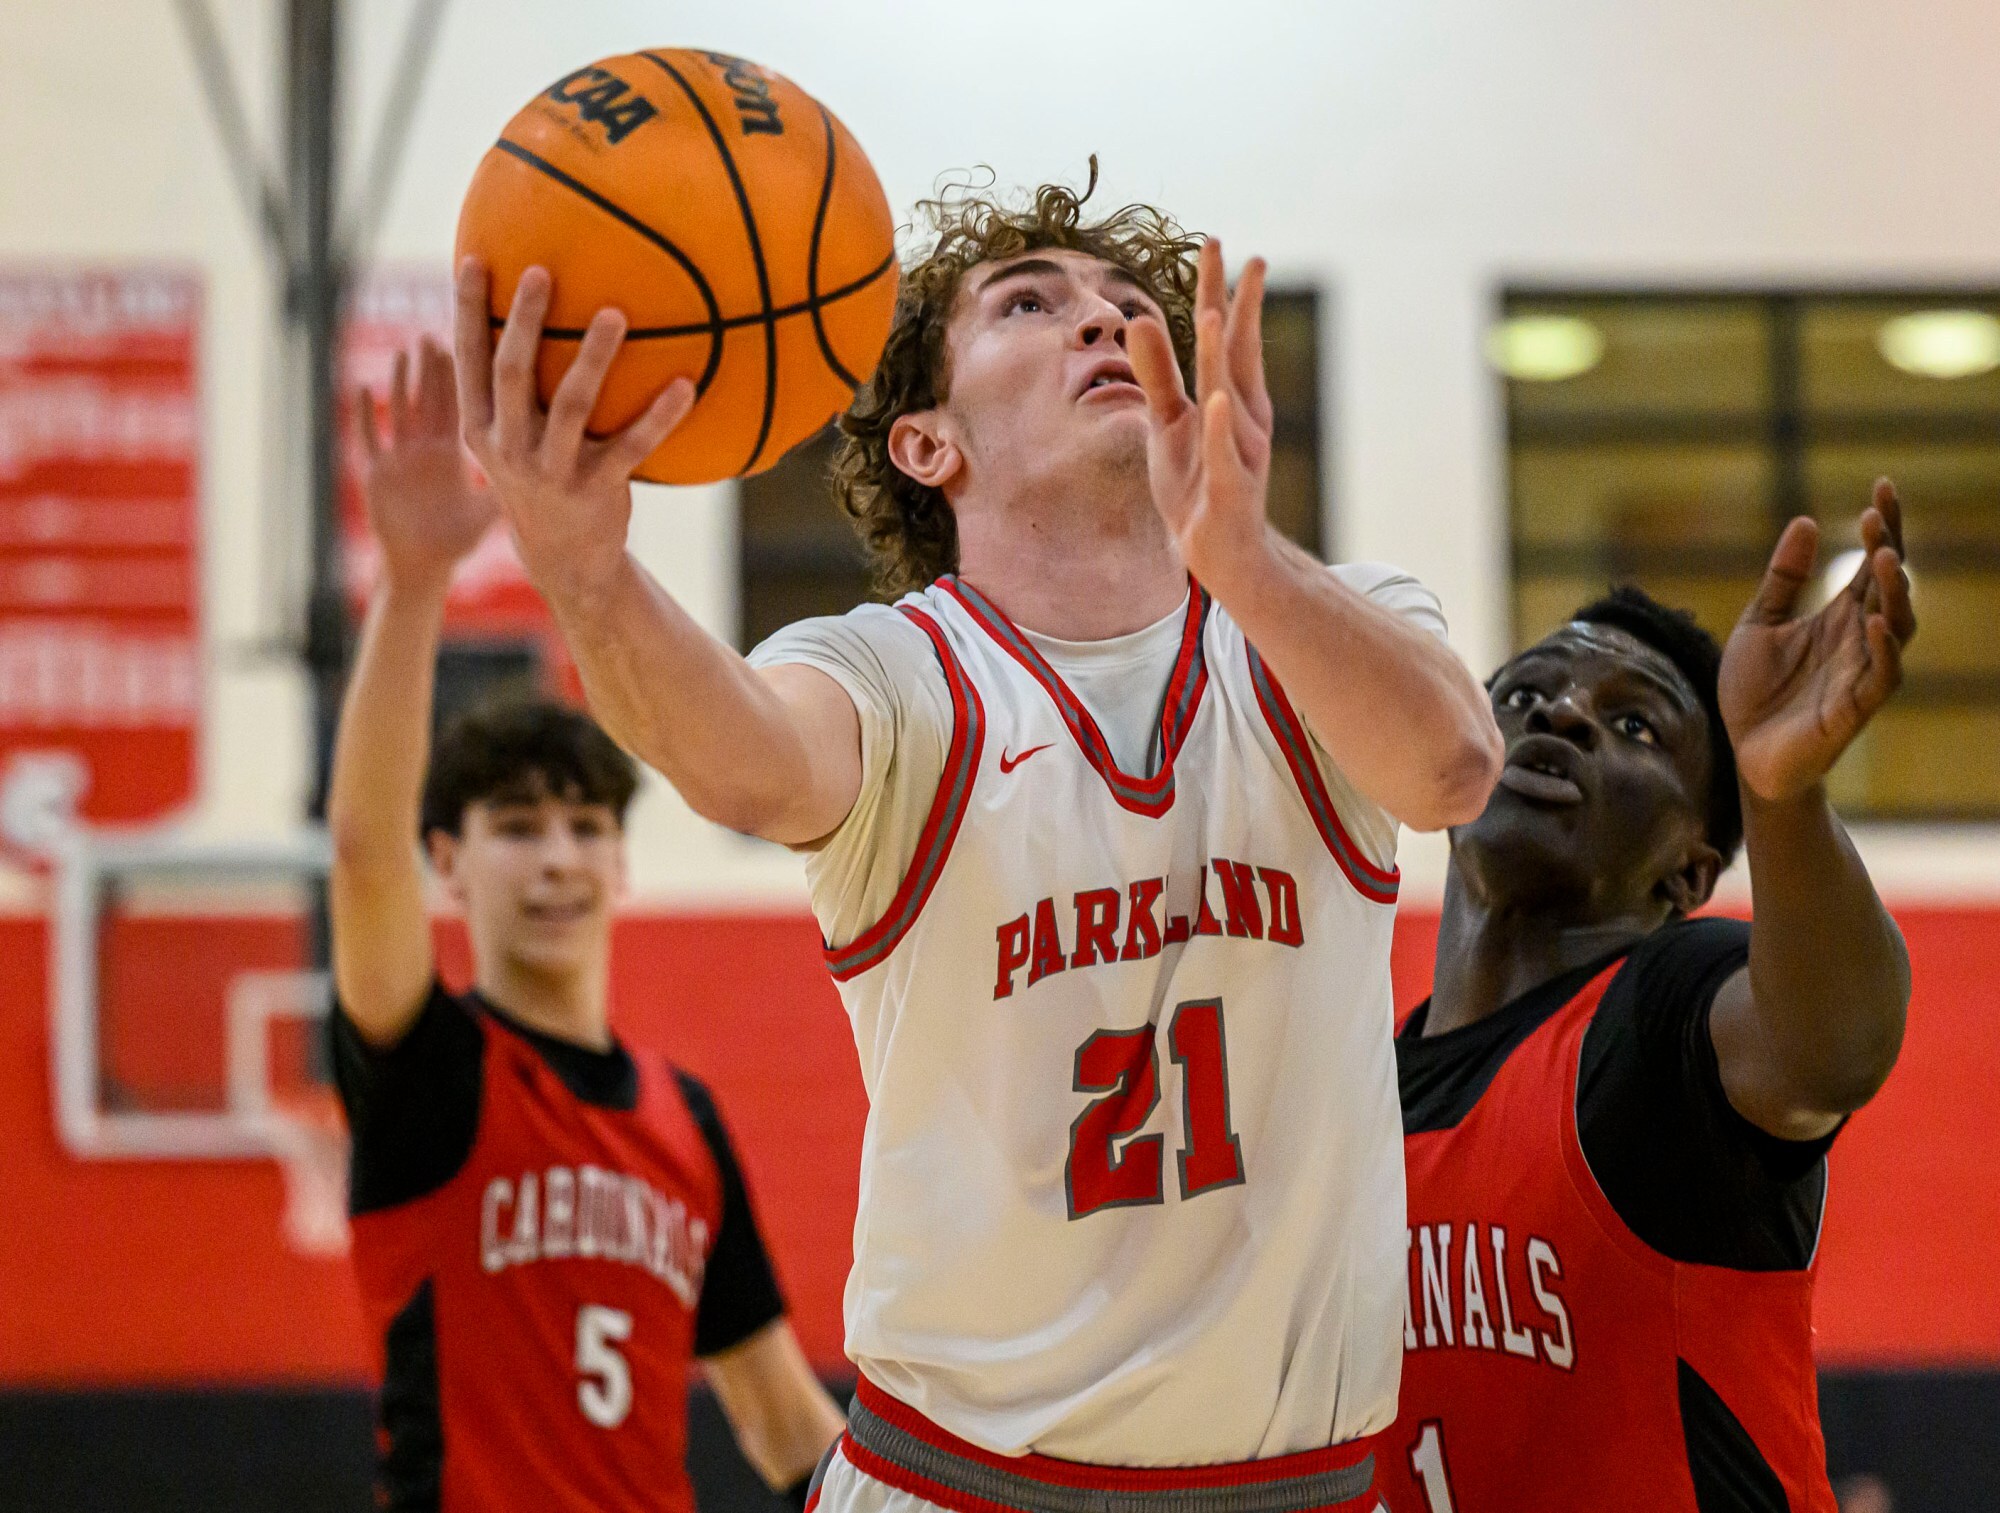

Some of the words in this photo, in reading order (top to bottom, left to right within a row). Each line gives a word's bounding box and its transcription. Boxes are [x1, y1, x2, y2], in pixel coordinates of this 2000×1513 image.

[550, 66, 658, 141] CAA
[1064, 996, 1246, 1221] 21
[576, 1302, 634, 1430] 5
[1406, 1418, 1456, 1513] 1
